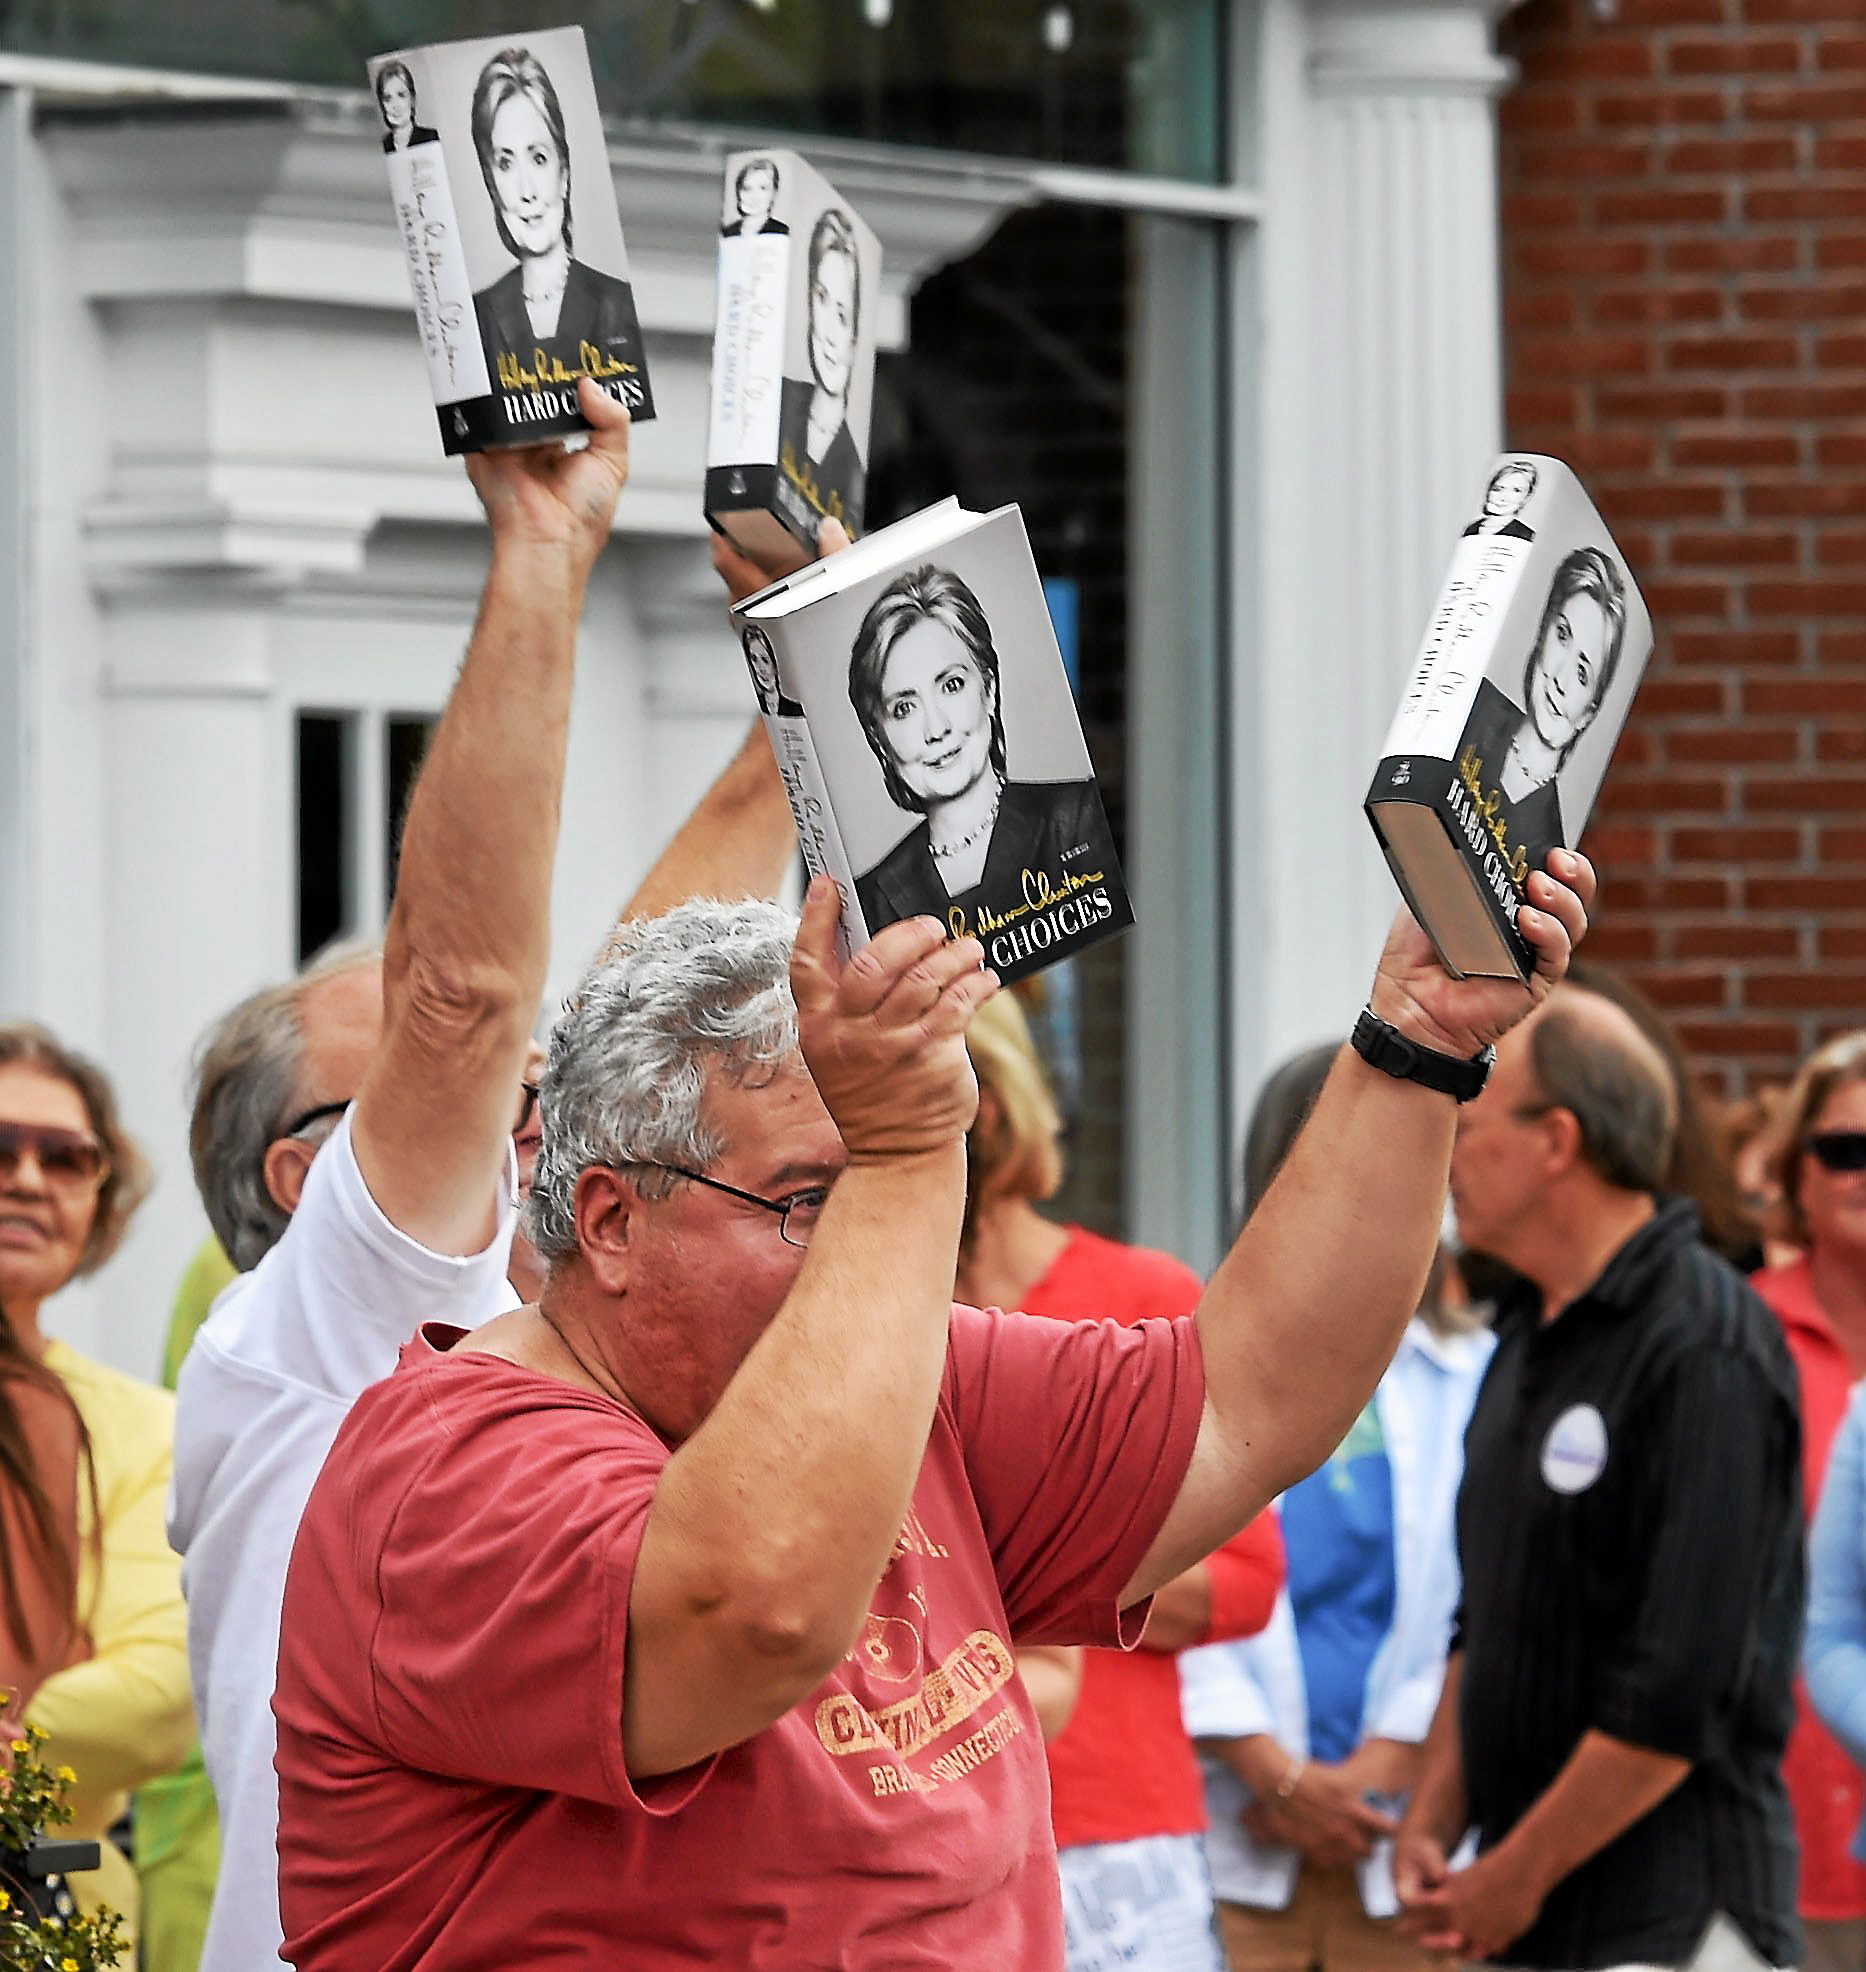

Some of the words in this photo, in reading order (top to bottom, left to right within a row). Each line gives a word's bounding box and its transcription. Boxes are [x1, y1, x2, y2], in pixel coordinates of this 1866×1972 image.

[503, 390, 560, 424] HARD
[1446, 778, 1488, 856] HARD
[1021, 868, 1104, 911] Clinton
[991, 887, 1113, 967] CHOICES
